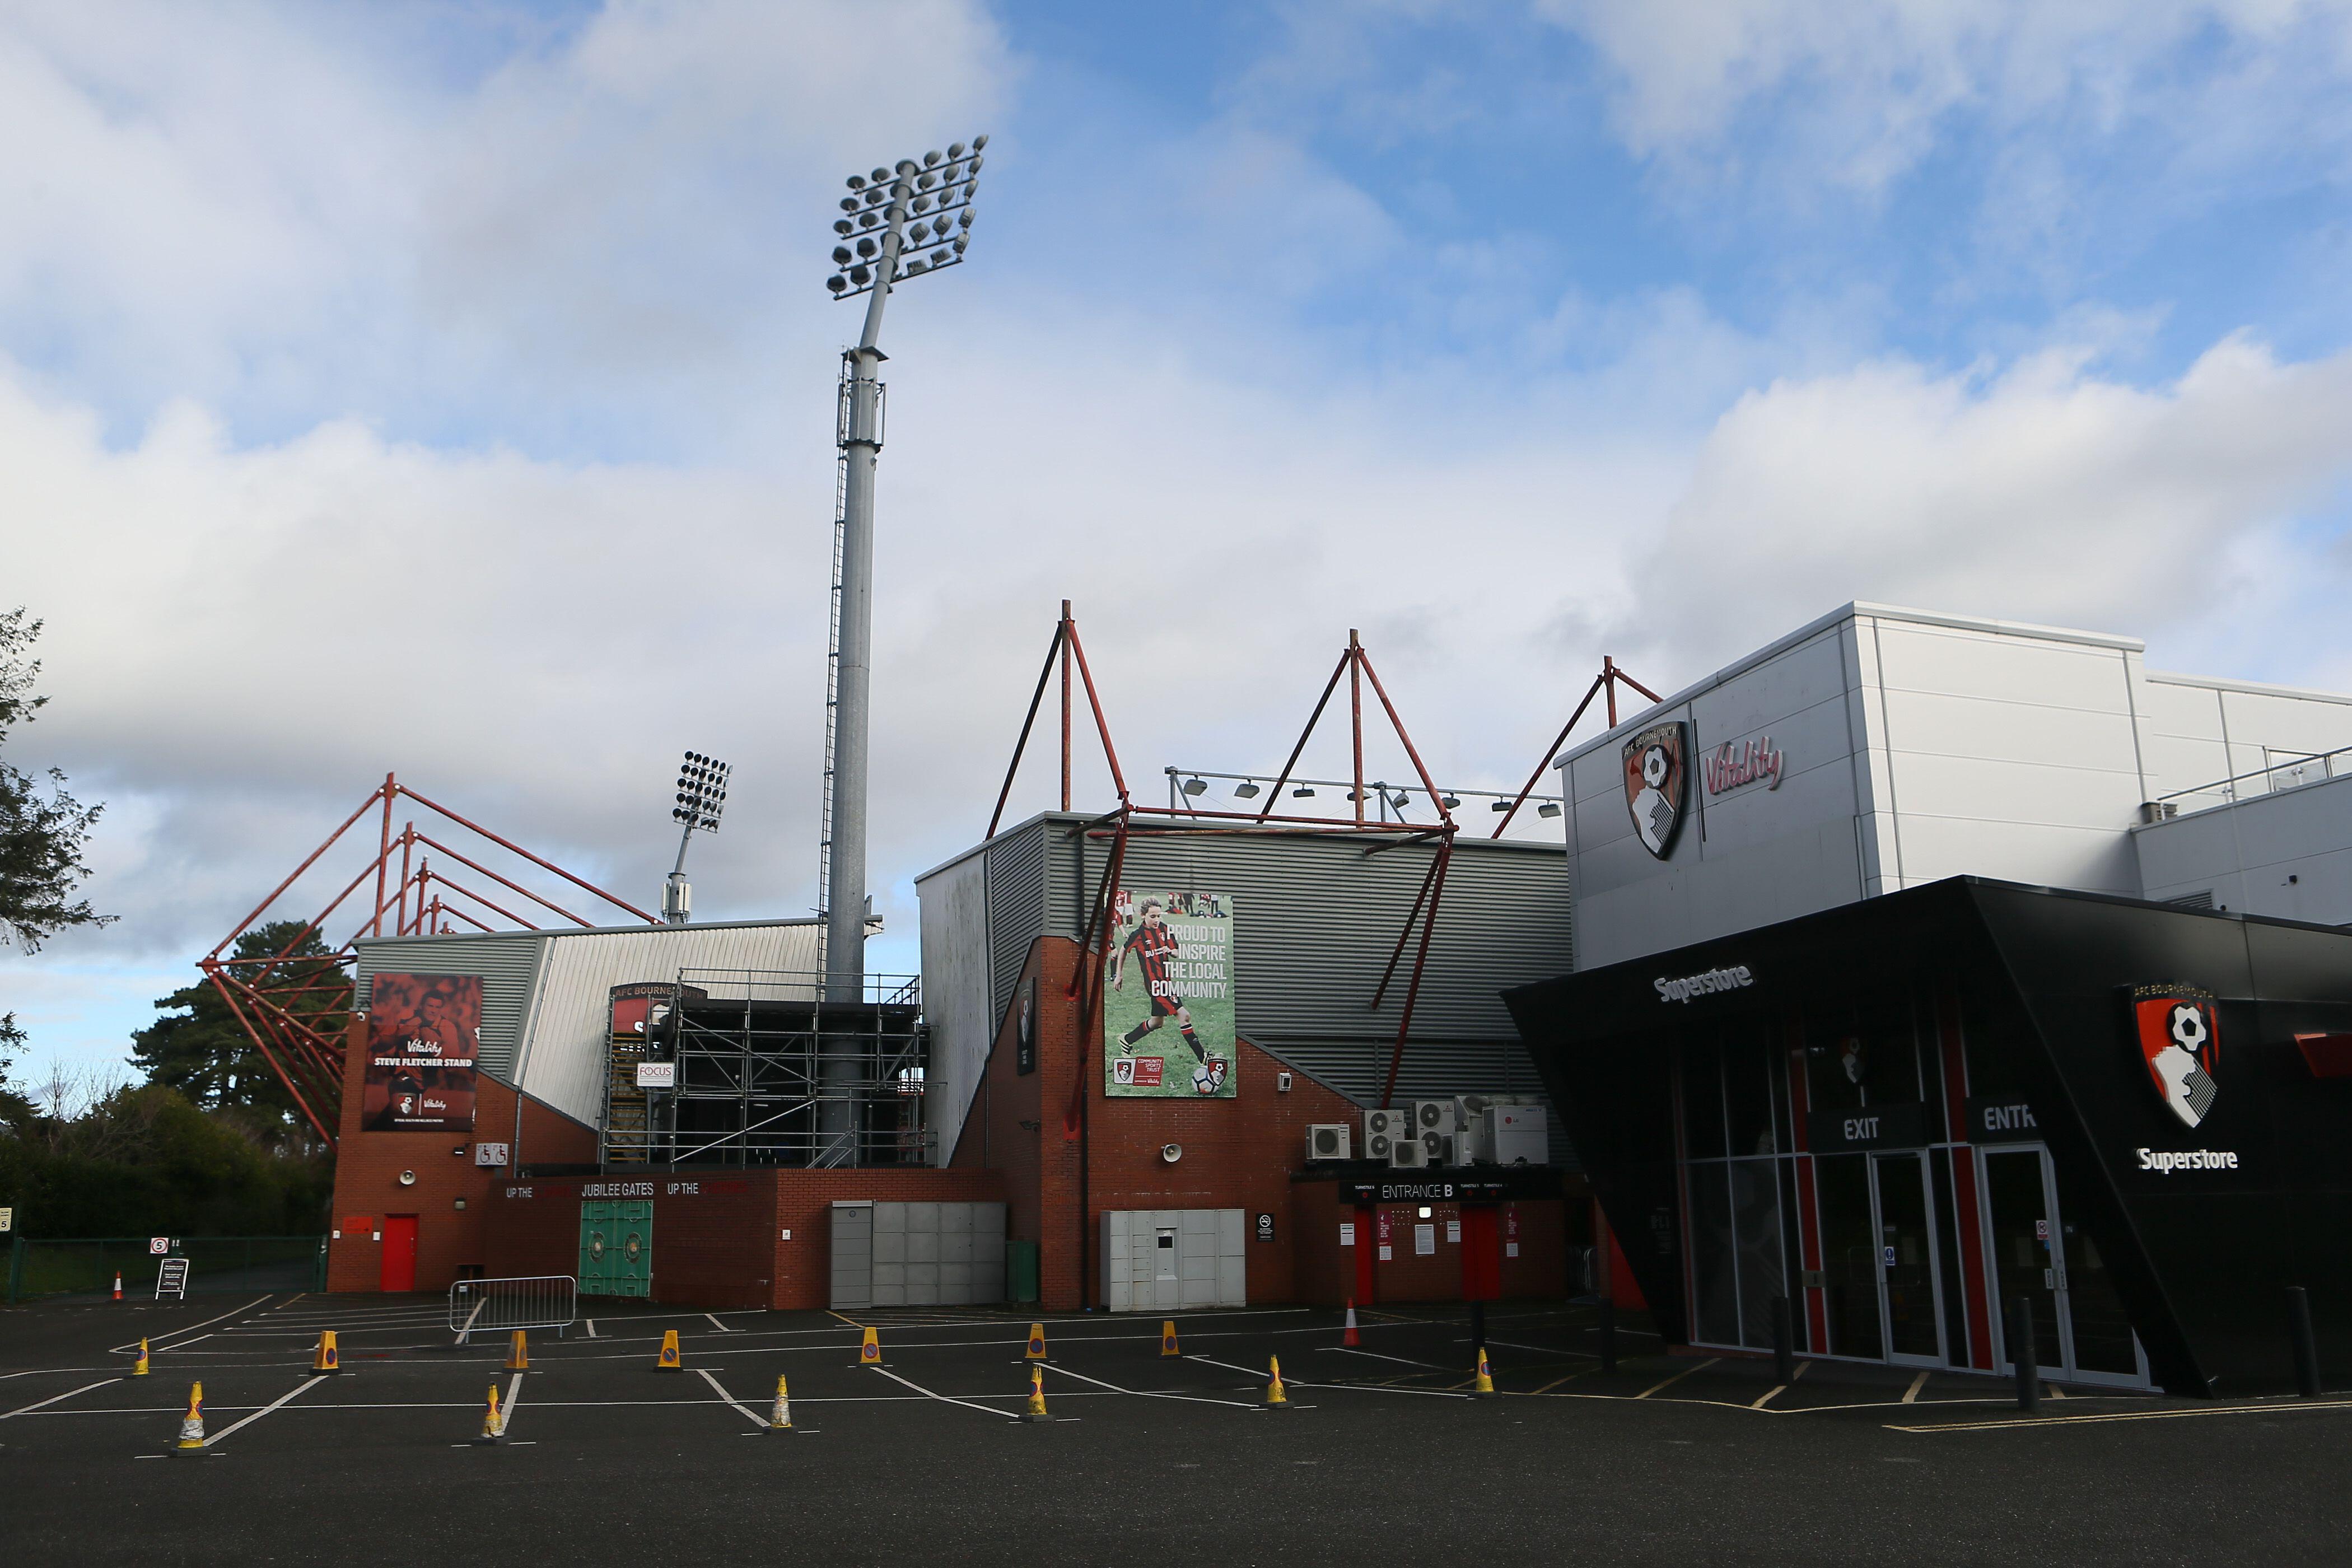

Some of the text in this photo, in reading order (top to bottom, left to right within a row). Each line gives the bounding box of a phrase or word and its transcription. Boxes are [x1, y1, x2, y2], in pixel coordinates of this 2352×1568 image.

[1625, 743, 1634, 757] AFC
[1706, 736, 1783, 794] Vitality
[1166, 924, 1225, 942] PROUD TO
[1178, 944, 1226, 961] INSPIRE
[1163, 962, 1227, 979] THE LOCAL
[616, 987, 703, 999] AFC BOURNEOUTH
[1151, 980, 1227, 998] COMMUNITY
[1654, 966, 1753, 1004] Superstore
[407, 1038, 442, 1057] Vitality
[375, 1058, 400, 1066] STEVE
[640, 1066, 671, 1076] FOCUS
[424, 1099, 446, 1110] Vitality
[1984, 1104, 2037, 1130] ENTR
[1844, 1117, 1879, 1140] EXIT
[2137, 1148, 2238, 1174] Superstore
[507, 1188, 517, 1197] UP
[519, 1188, 532, 1197] THE
[582, 1184, 620, 1196] JUBILEE
[622, 1183, 654, 1196] GATES
[668, 1183, 679, 1194] UP
[682, 1183, 698, 1194] THE
[1383, 1184, 1453, 1198] ENTRANCE B
